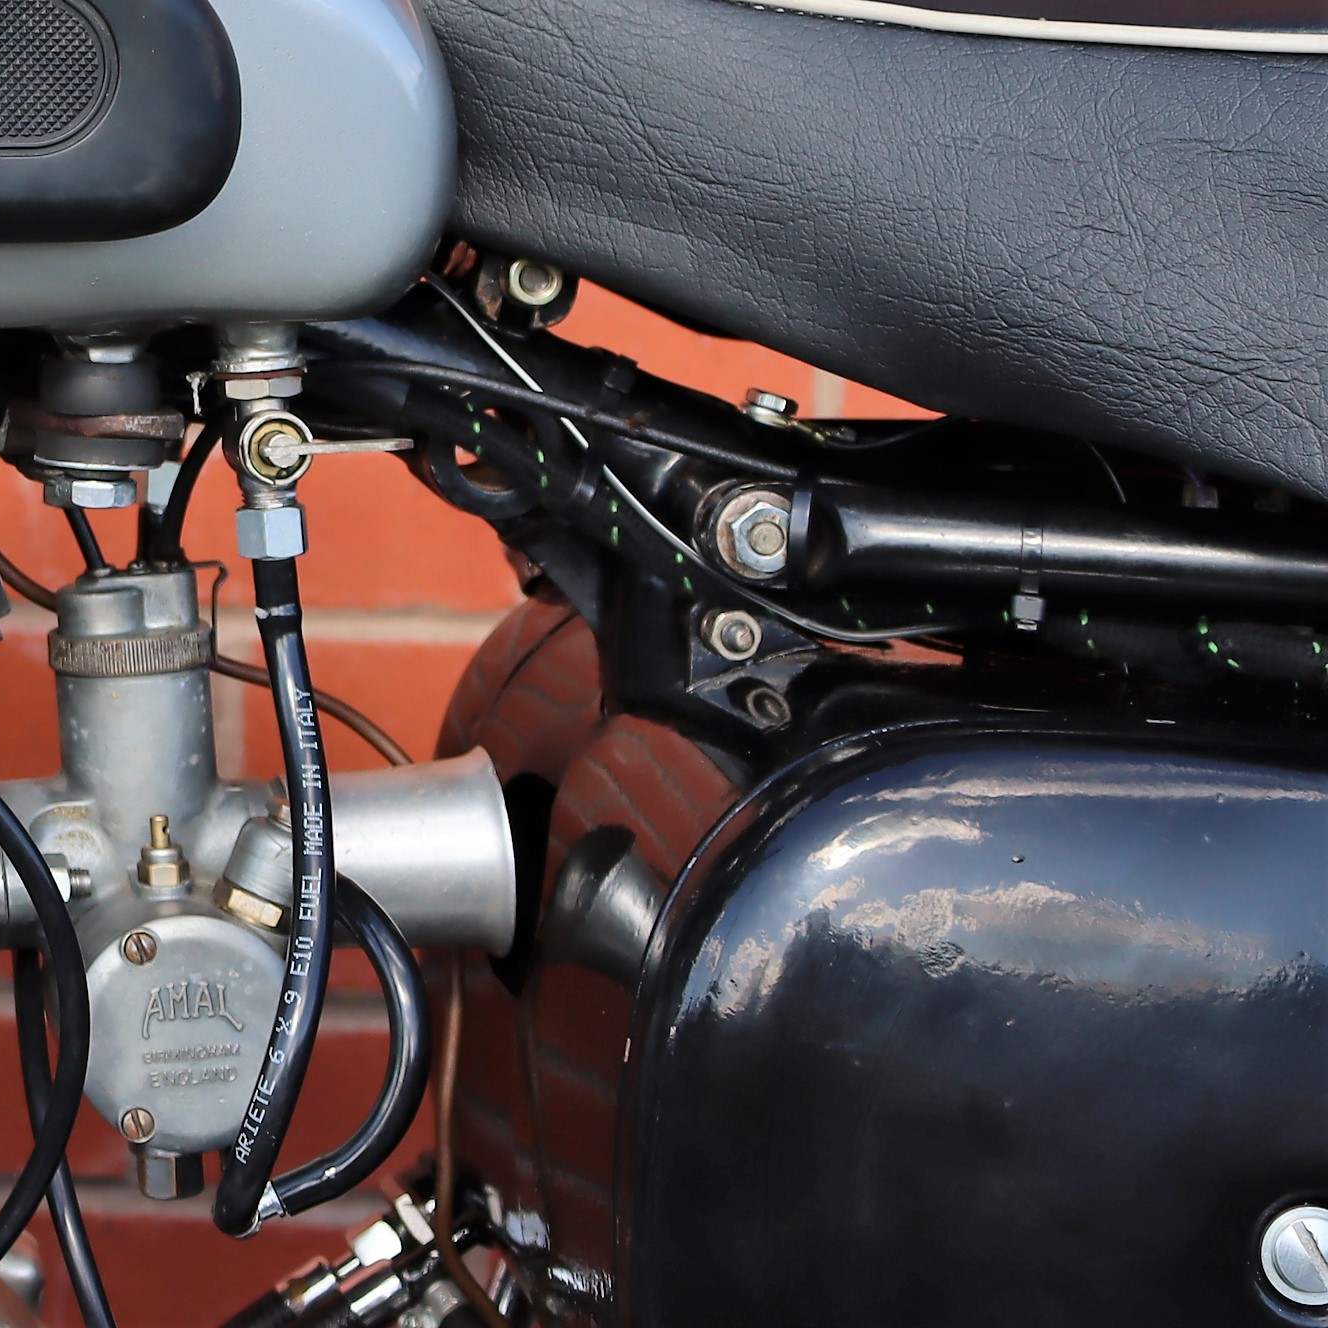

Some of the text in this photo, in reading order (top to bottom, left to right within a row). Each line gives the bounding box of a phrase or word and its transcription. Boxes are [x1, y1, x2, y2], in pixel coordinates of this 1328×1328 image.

[294, 688, 318, 750] ITALY
[301, 764, 322, 789] IN
[303, 802, 323, 856] MADE
[299, 868, 322, 920] FUEL
[290, 936, 314, 976] E10
[142, 980, 244, 1039] AMAL
[284, 989, 301, 1005] 9
[144, 1043, 241, 1063] BIRMINGHAM
[269, 1046, 286, 1064] 6
[150, 1065, 237, 1088] ENGLAND
[234, 1074, 276, 1164] ARIETE
